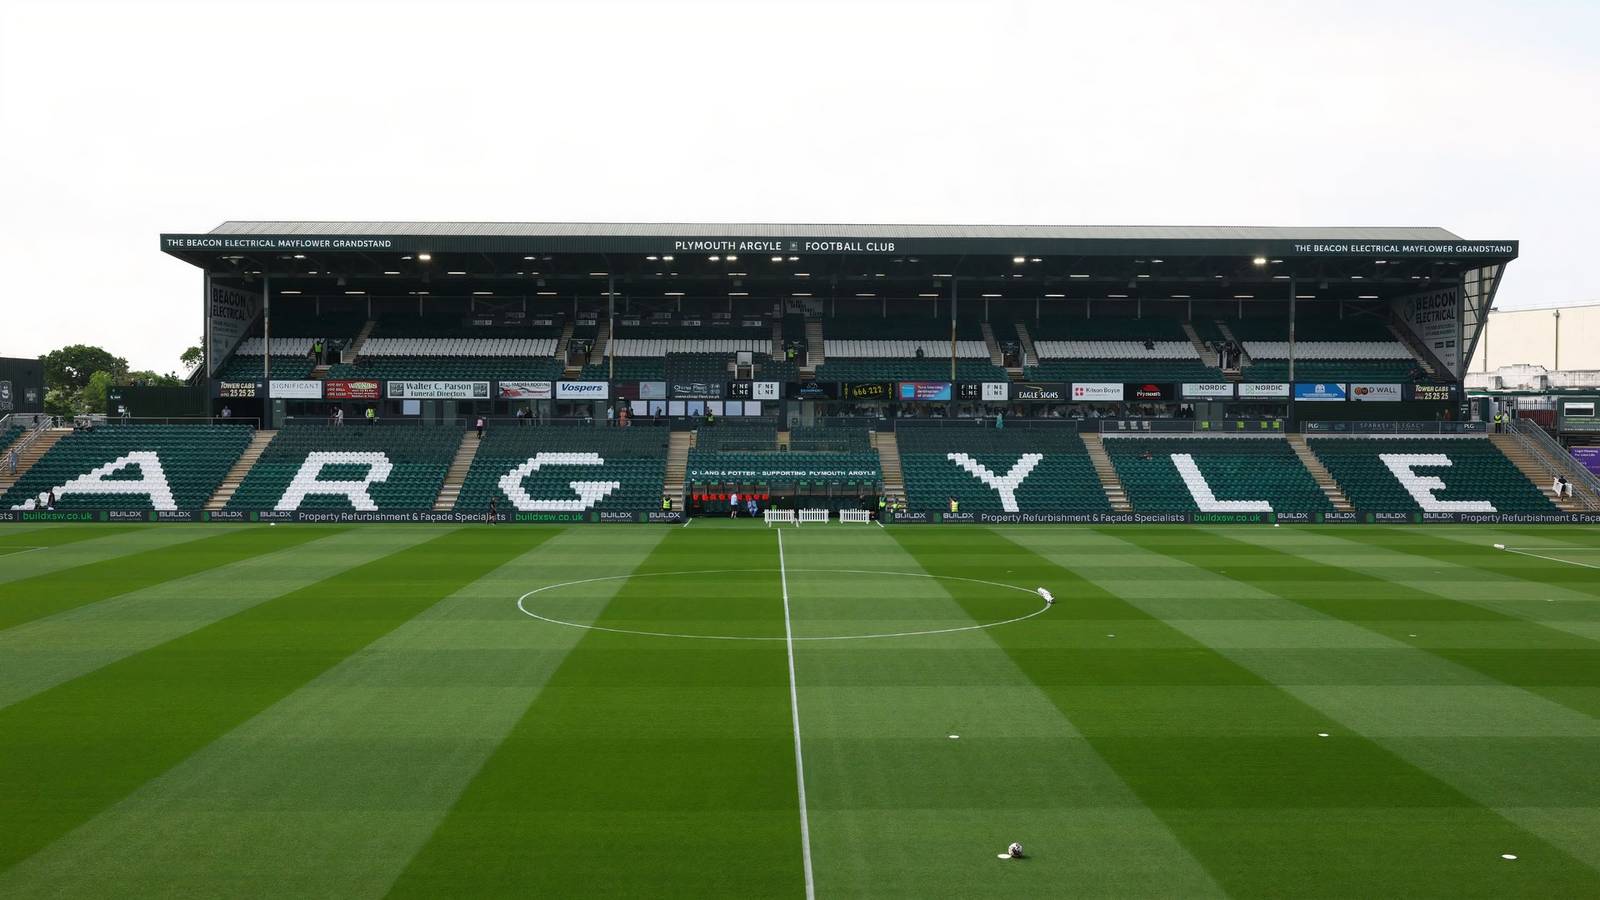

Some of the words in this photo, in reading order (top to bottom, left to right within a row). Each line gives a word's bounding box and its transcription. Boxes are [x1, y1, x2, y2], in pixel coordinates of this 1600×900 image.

[167, 238, 184, 247] THE
[186, 239, 222, 247] BEACON
[224, 239, 276, 248] ELECTRICAL
[278, 240, 330, 248] MAYFLOWER
[333, 240, 392, 248] GRANDSTAND
[675, 241, 736, 250] PLYMOUTH
[739, 241, 782, 250] ARGYLE
[805, 241, 863, 251] FOOTBALL
[866, 242, 895, 251] CLUB
[1294, 244, 1311, 252] THE
[1313, 244, 1348, 252] BEACON
[1351, 244, 1400, 253] ELECTRICAL
[1402, 244, 1453, 253] MAYFLOWER
[1455, 245, 1513, 253] GRANDSTAND
[212, 287, 246, 307] BEACON
[1416, 291, 1456, 310] BEACON
[212, 305, 247, 320] ELECTRICAL
[1416, 310, 1455, 324] ELECTRICAL
[406, 383, 432, 391] Walter
[434, 383, 442, 391] C.
[444, 382, 472, 391] Parson
[561, 383, 603, 392] Vospers
[1377, 386, 1397, 394] WALL
[230, 389, 238, 397] 25
[238, 389, 246, 397] 25
[247, 389, 255, 397] 25
[1019, 391, 1039, 399] EAGLE
[1040, 391, 1059, 399] SIGNS
[1425, 392, 1432, 400] 25
[1433, 392, 1440, 400] 25
[1441, 392, 1449, 400] 25
[22, 511, 92, 520] buildxsw.co.uk
[299, 512, 339, 523] Property
[341, 511, 410, 521] Refurbishment
[412, 512, 419, 521] &
[420, 511, 452, 523] Façade
[454, 511, 506, 523] Specialits
[515, 512, 584, 521] buildxsw.co.uk
[981, 513, 1021, 523] Property
[1023, 513, 1091, 522] Refurbishment
[1092, 513, 1099, 522] &
[1101, 513, 1133, 524] Façade
[1135, 513, 1185, 522] Specialists
[1194, 513, 1261, 522] buildxsw.co.uk
[1460, 513, 1500, 524] Property
[1502, 513, 1570, 522] Refurbishment
[1571, 513, 1578, 522] &
